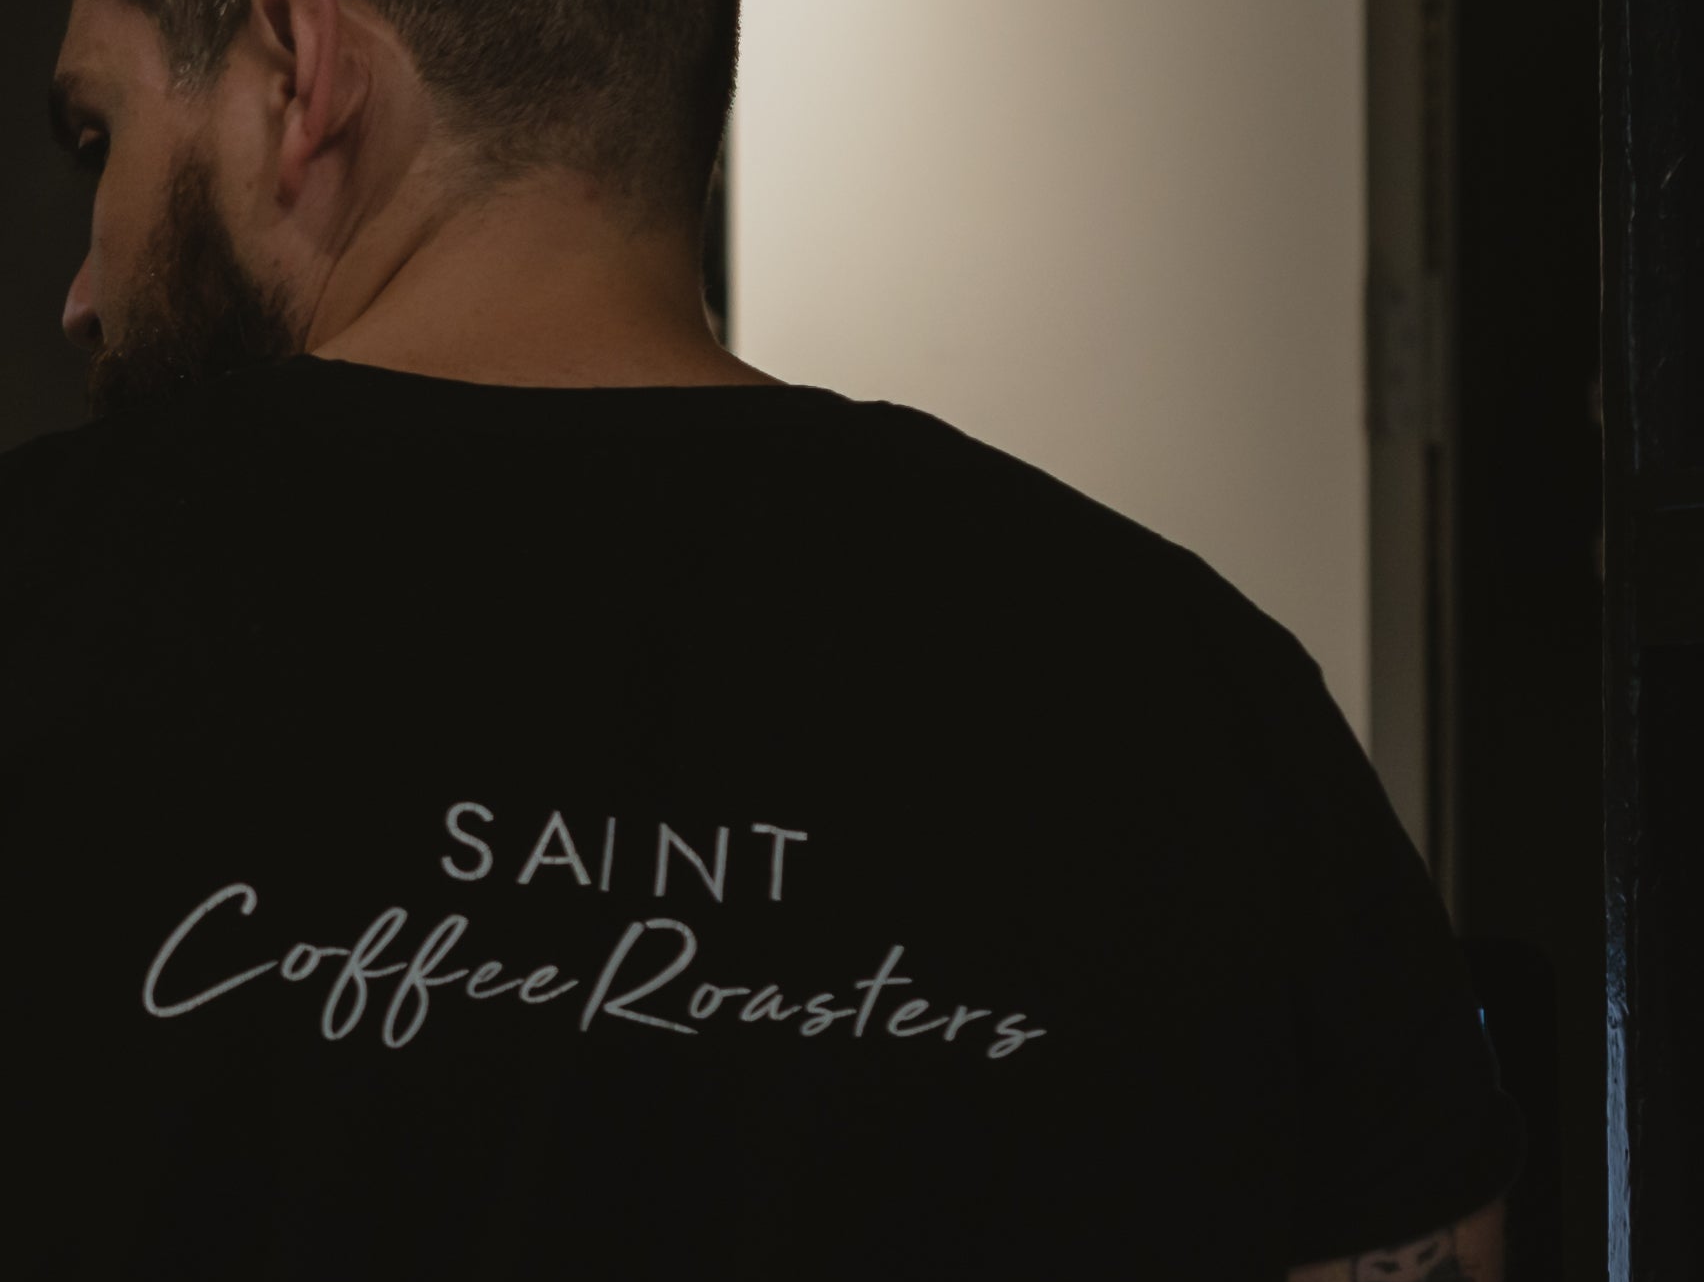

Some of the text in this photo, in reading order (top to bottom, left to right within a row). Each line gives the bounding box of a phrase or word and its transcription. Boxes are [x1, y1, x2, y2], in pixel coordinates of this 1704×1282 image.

[440, 800, 808, 904] SAINT
[142, 882, 1047, 1059] Coffee Roasters
